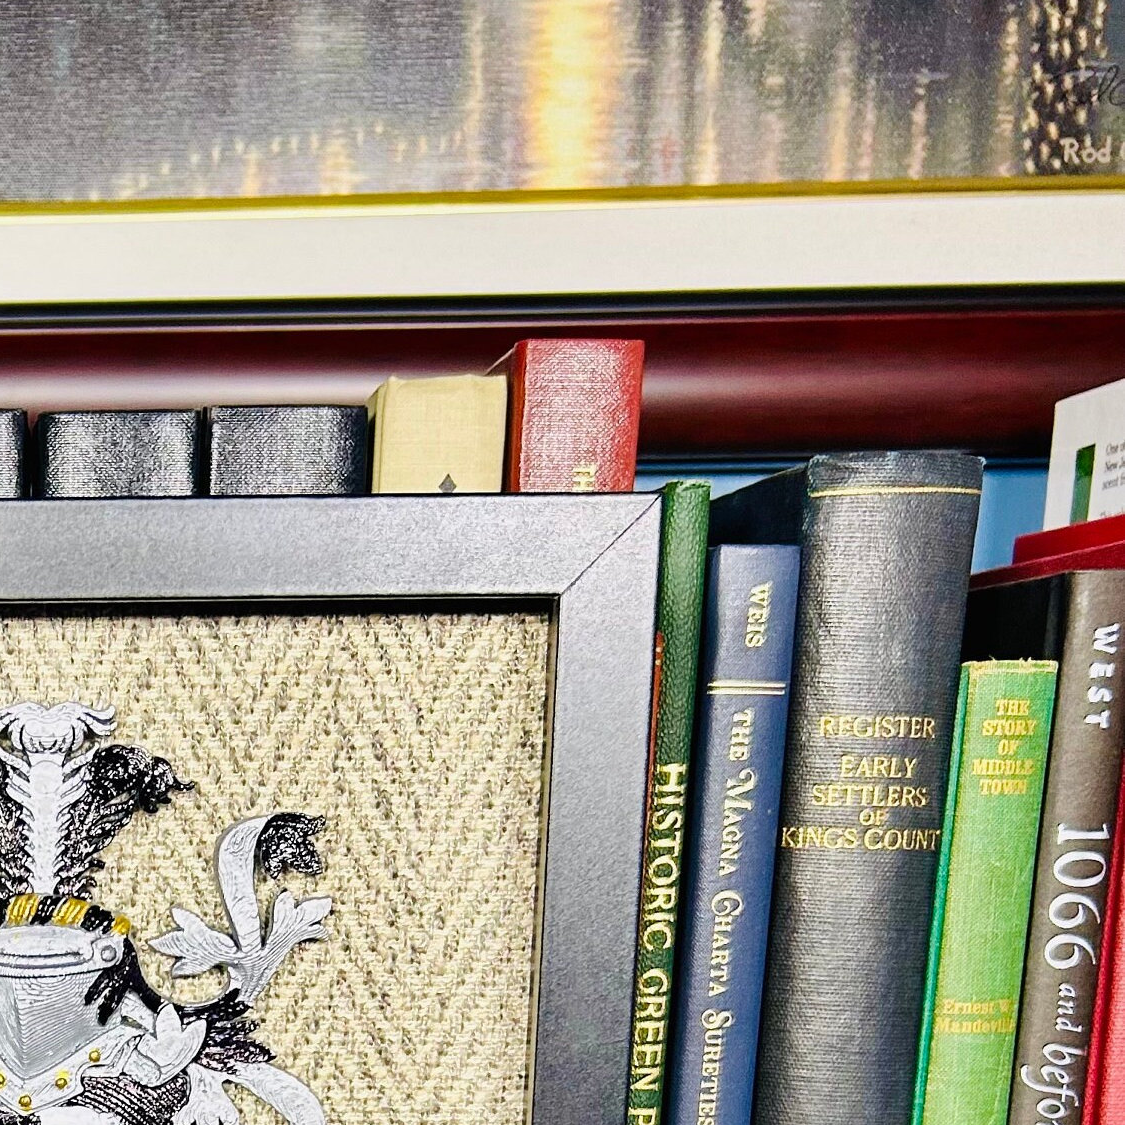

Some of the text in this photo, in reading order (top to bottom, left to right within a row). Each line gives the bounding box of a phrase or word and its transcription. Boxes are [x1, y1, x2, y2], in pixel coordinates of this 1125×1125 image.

[1058, 134, 1112, 165] Rod
[744, 580, 773, 648] WEIS
[1083, 623, 1121, 729] WEST
[995, 699, 1030, 716] THE
[729, 707, 755, 762] THE
[819, 714, 936, 739] REGISTER
[981, 719, 1037, 736] STORY
[997, 739, 1020, 756] OF
[839, 755, 917, 779] EARLY
[971, 758, 1036, 775] MIDDLE
[811, 783, 928, 808] SETTLERS
[979, 778, 1028, 796] TOWN
[858, 808, 889, 827] OF
[781, 827, 859, 850] KINGS
[642, 762, 688, 951] HISTORIC
[1044, 822, 1111, 970] 1066
[942, 998, 995, 1015] Ernest
[1055, 981, 1084, 1033] and
[630, 967, 672, 1092] GREEN
